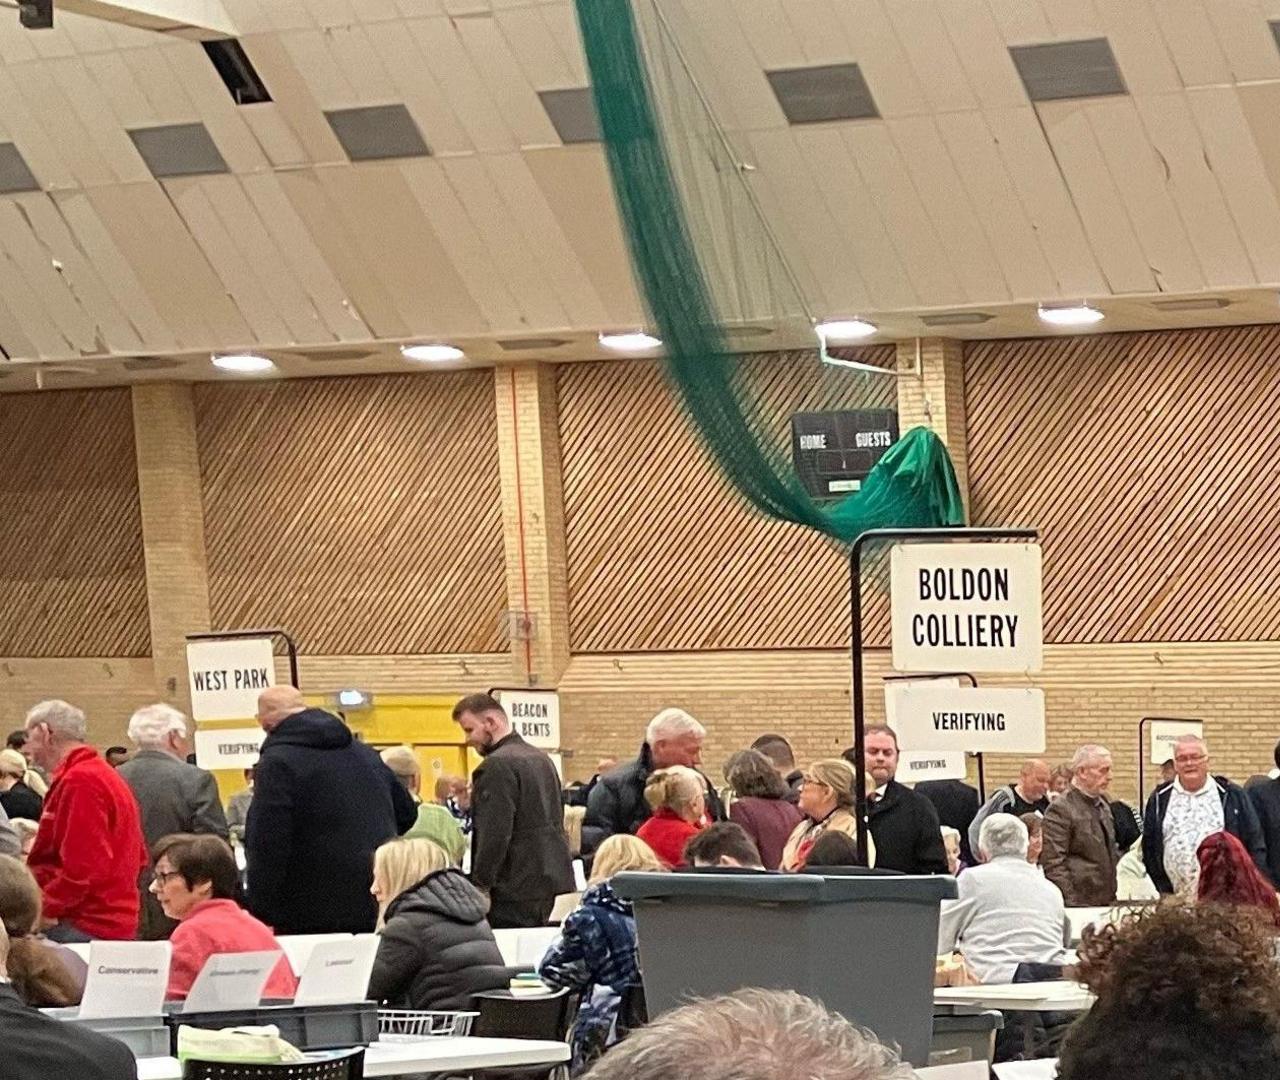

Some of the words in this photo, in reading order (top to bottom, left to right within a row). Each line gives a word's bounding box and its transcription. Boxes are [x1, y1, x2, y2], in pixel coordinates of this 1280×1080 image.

[800, 434, 827, 449] HOME
[855, 431, 891, 447] GUESTS
[919, 568, 1009, 601] BOLDON
[912, 614, 1019, 647] COLLIERY
[193, 670, 228, 691] WEST
[234, 668, 270, 689] PARK
[512, 703, 548, 717] BEACON
[522, 722, 551, 737] BENTS
[933, 712, 1005, 731] VERIFYING
[910, 759, 946, 770] VERIFYING
